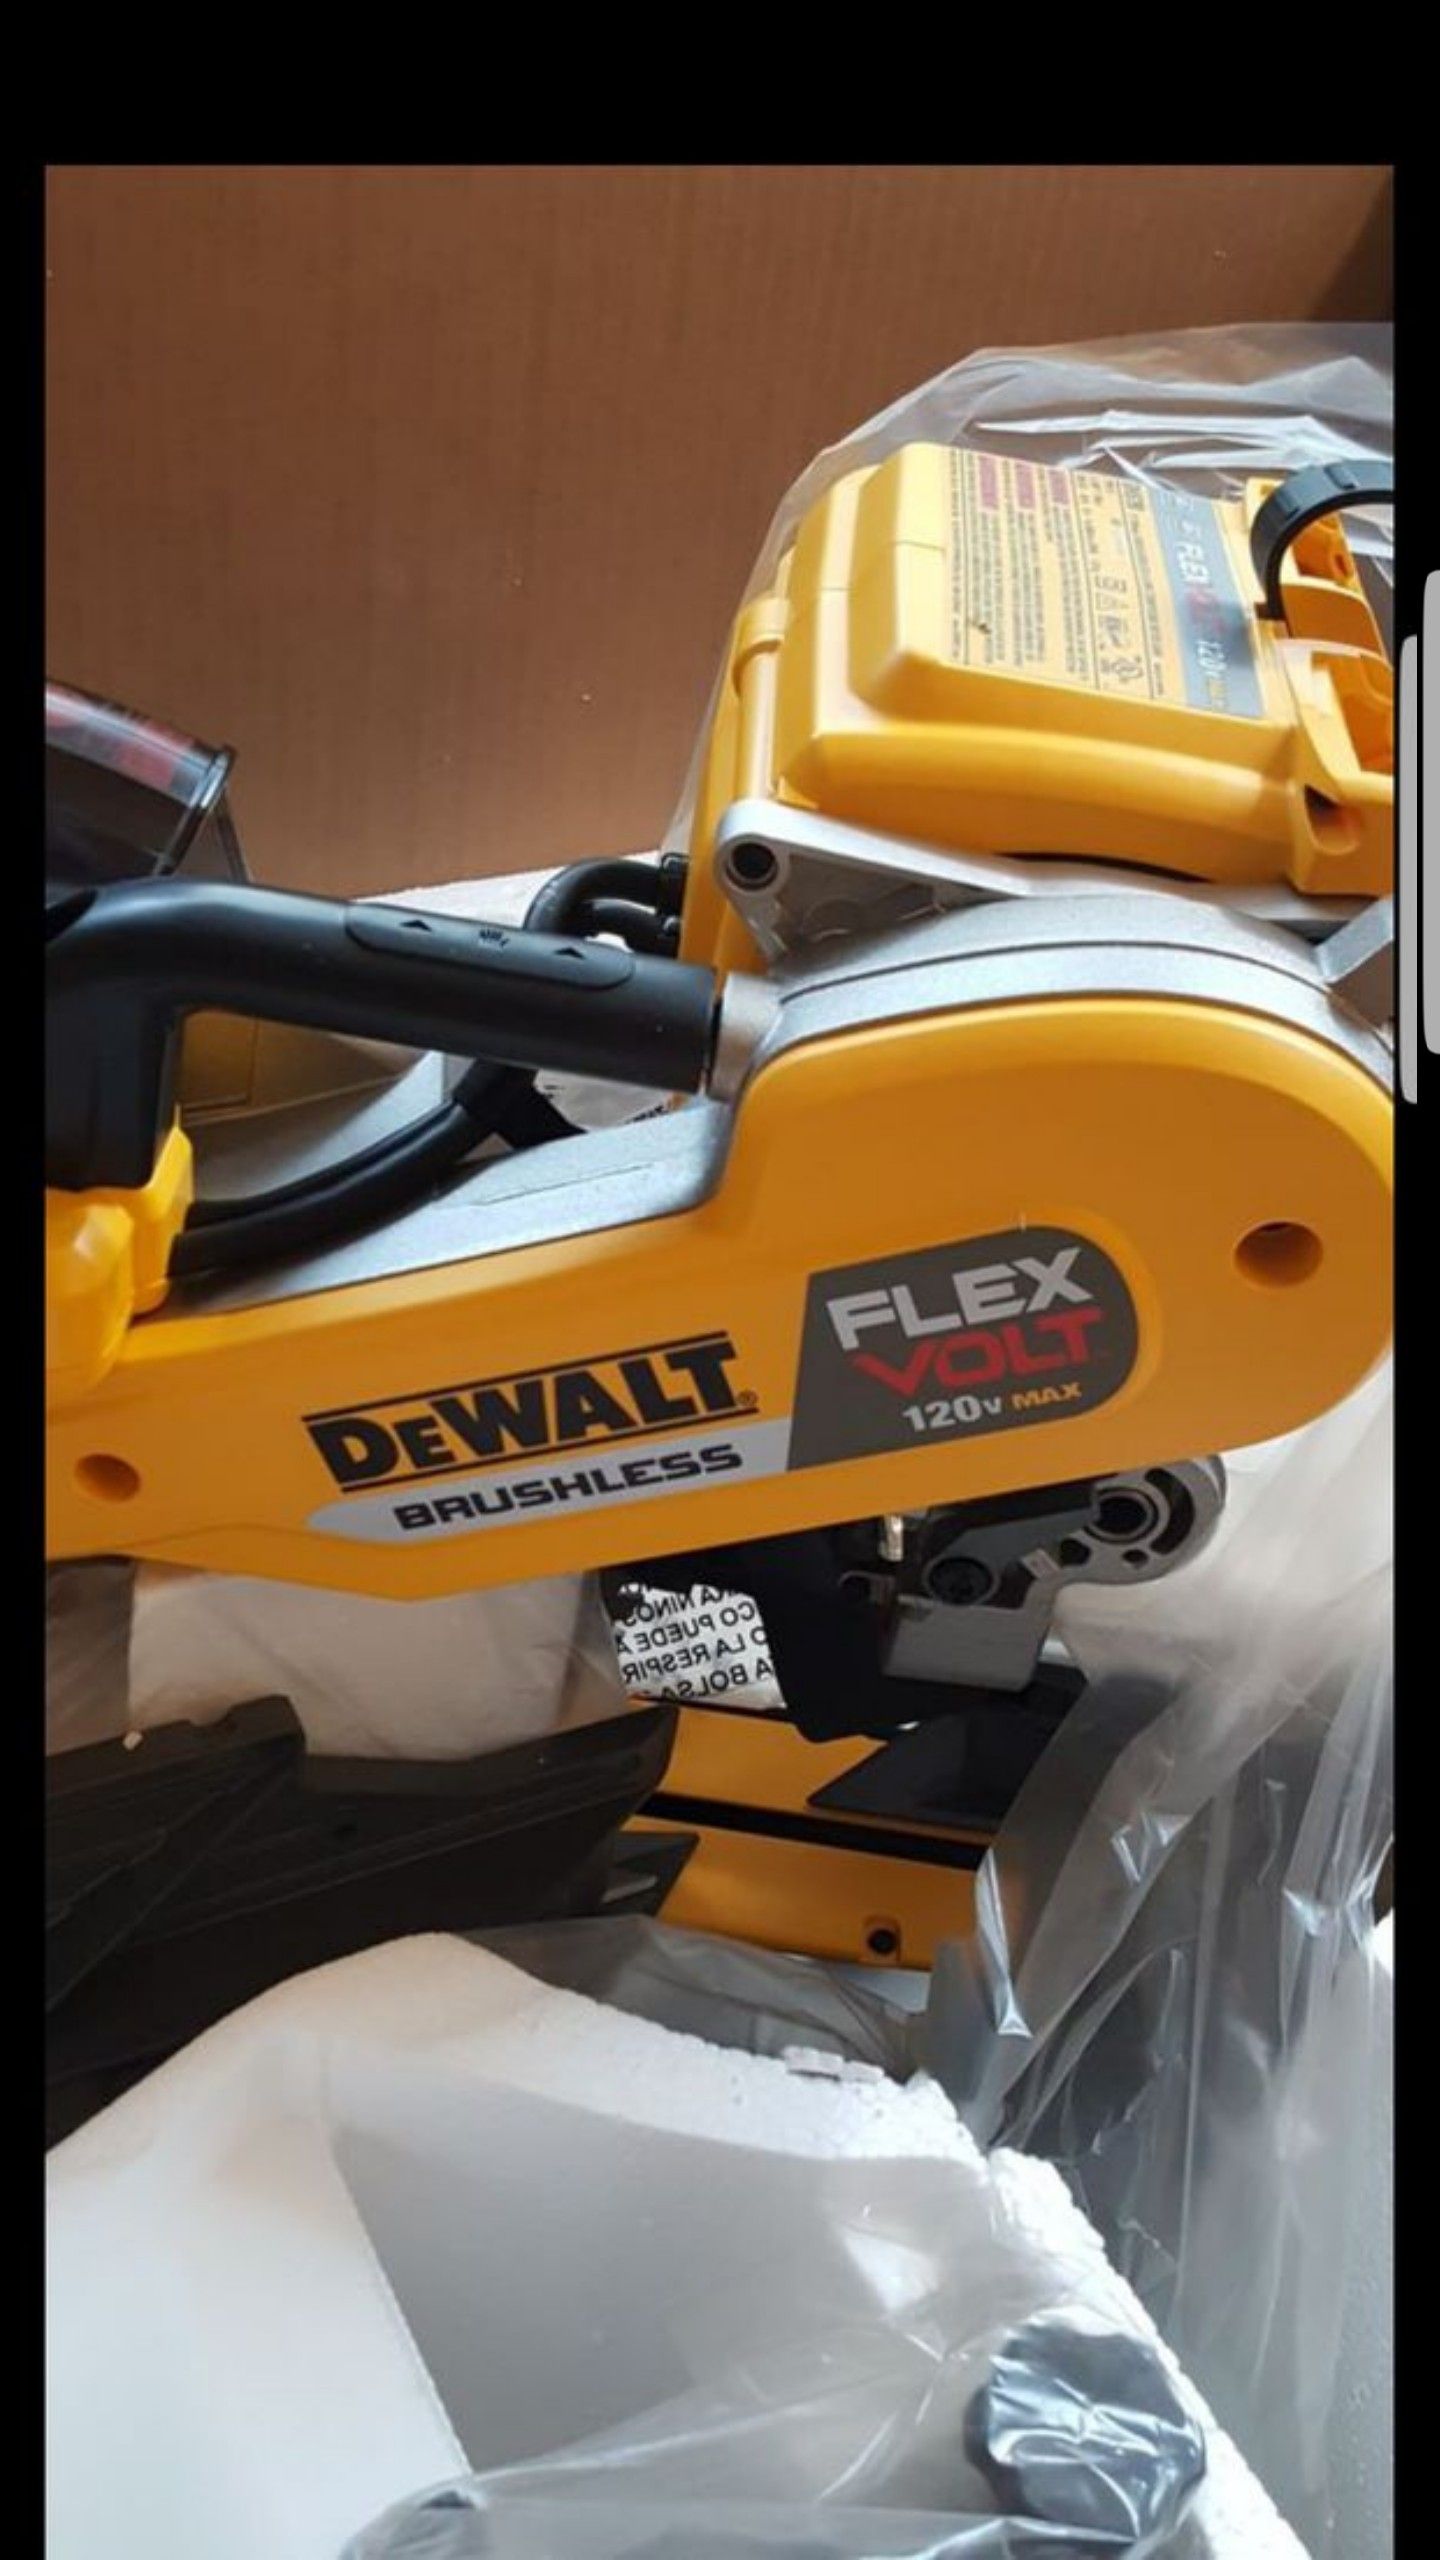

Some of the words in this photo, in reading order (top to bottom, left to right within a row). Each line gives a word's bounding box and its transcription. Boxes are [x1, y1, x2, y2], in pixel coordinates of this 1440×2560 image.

[826, 1247, 1094, 1351] FLEX
[852, 1306, 1105, 1398] VOLT
[1011, 1382, 1082, 1411] MAX
[394, 1444, 744, 1531] BRUSHLESS
